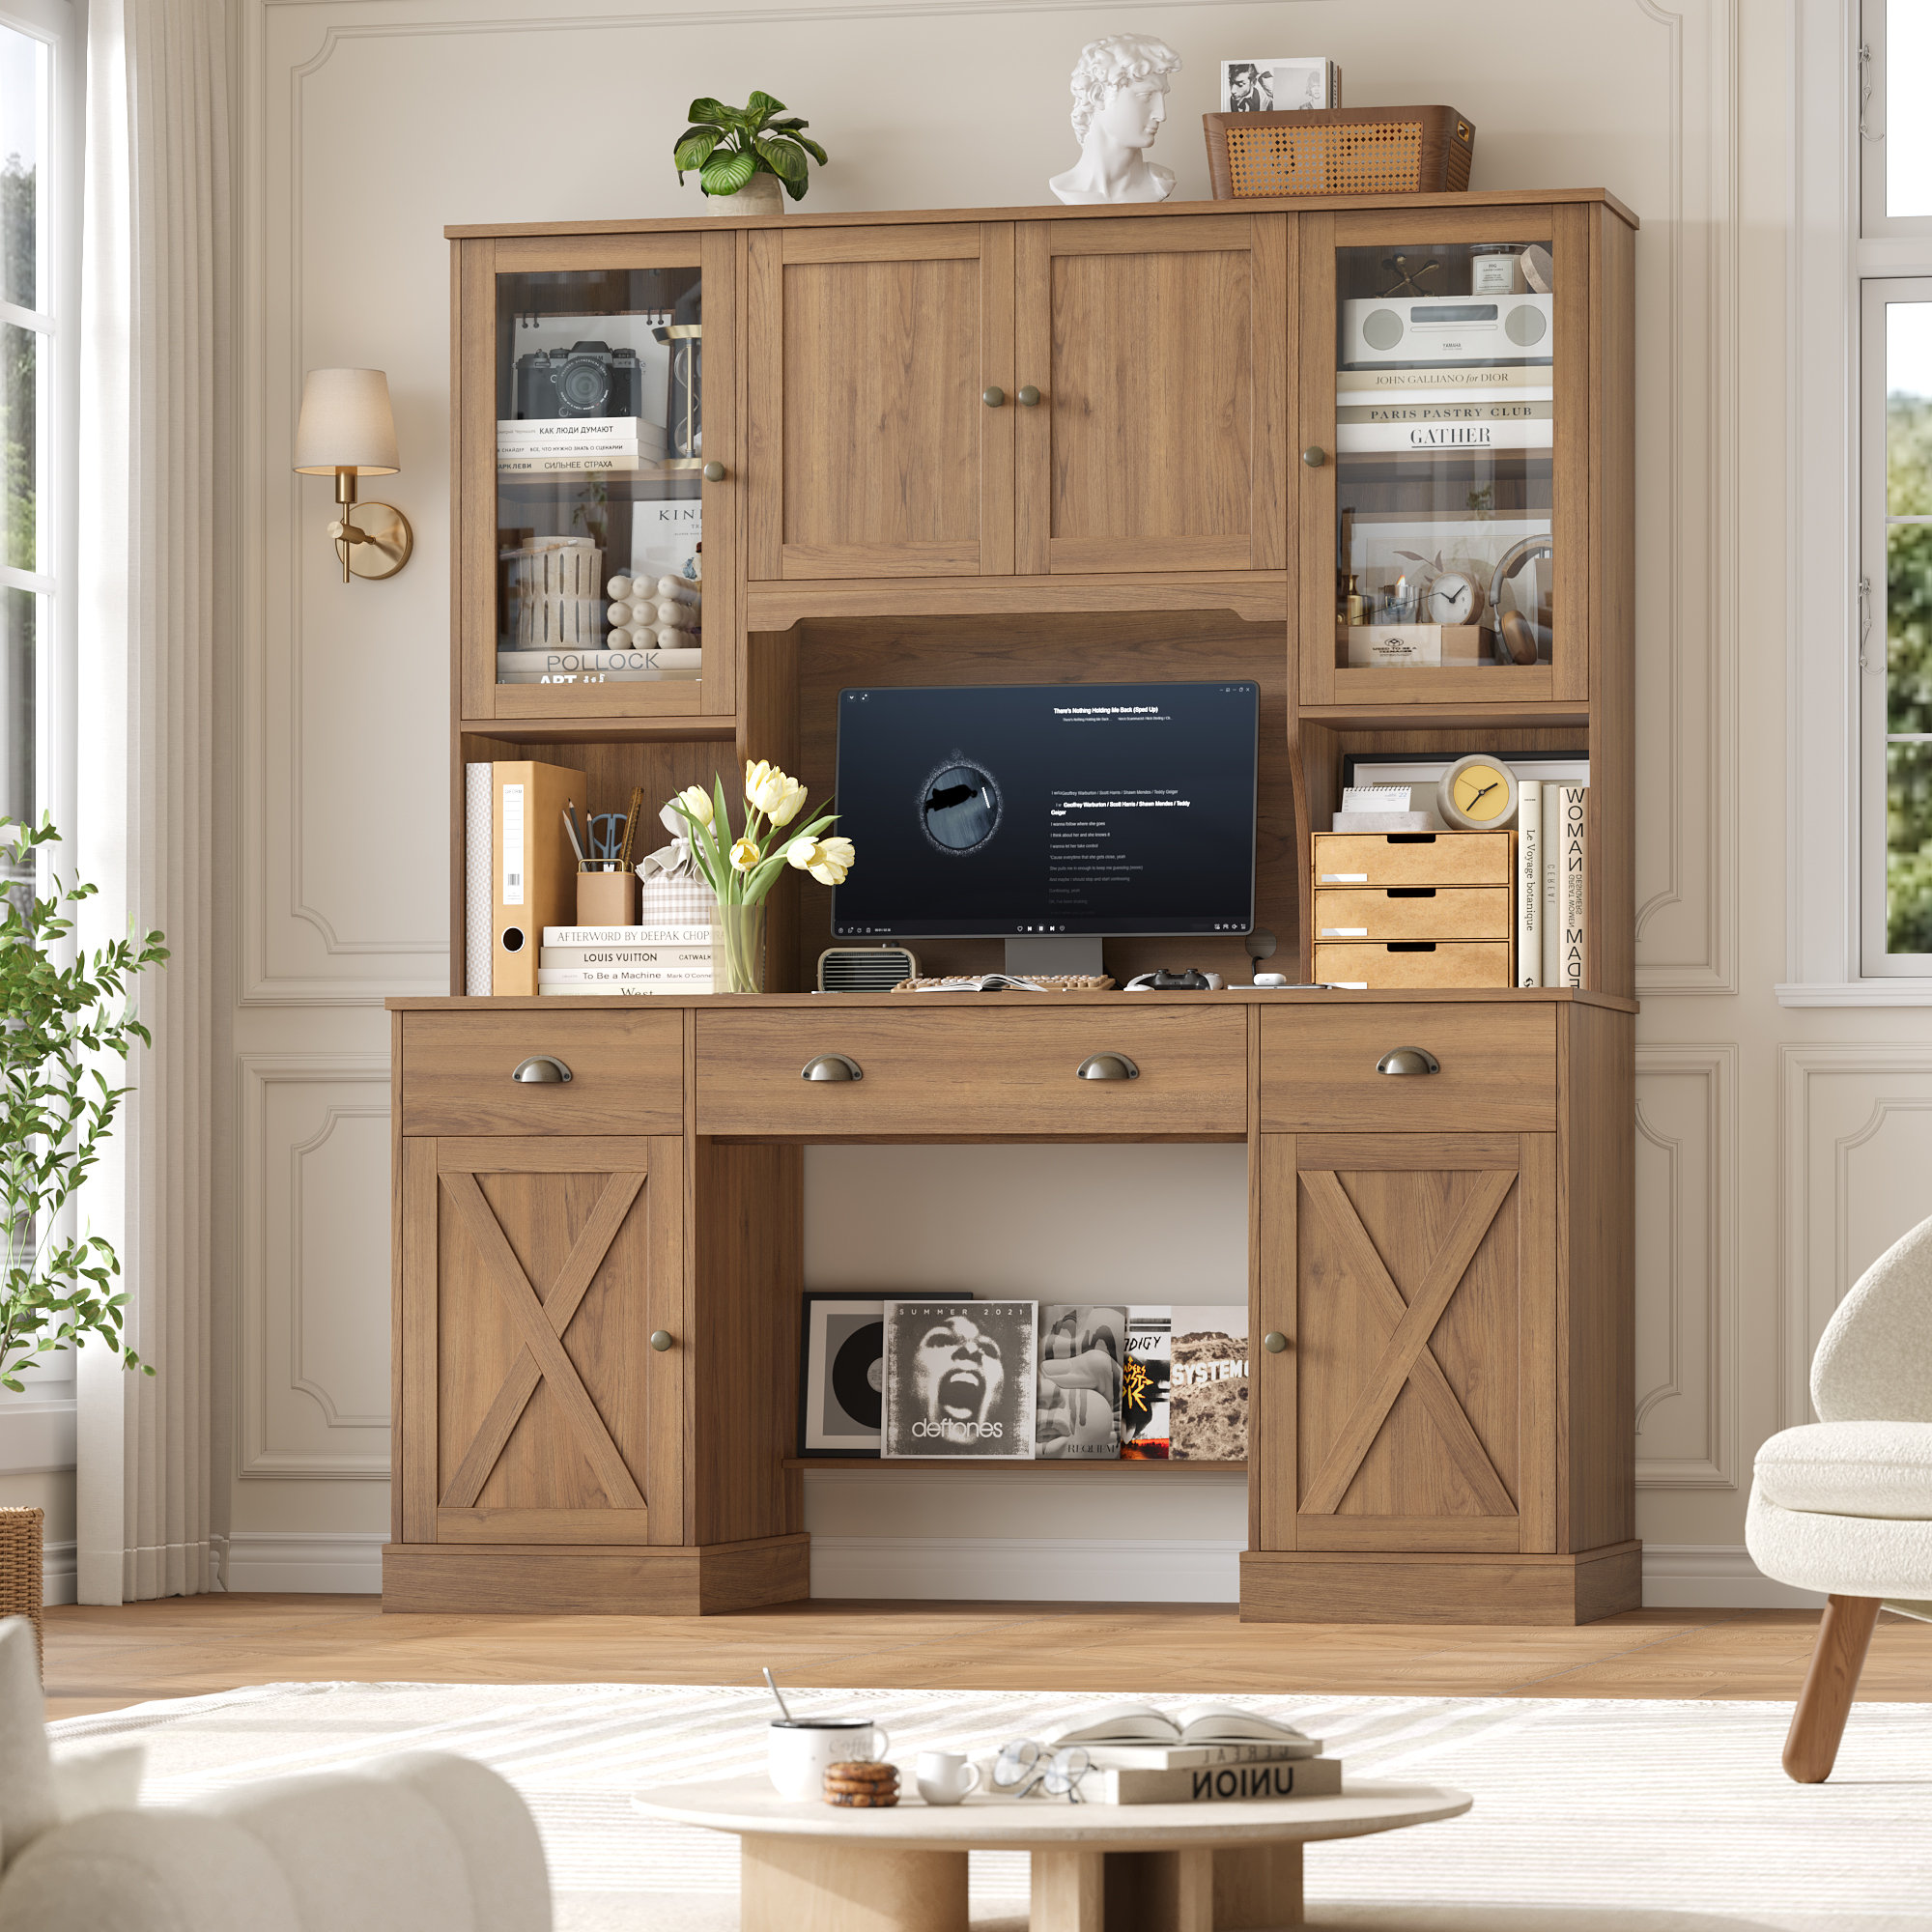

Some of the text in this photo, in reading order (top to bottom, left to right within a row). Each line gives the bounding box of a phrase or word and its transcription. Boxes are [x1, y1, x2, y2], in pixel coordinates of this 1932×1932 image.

[1376, 373, 1509, 384] JOHN GALLIANO for DIOR
[1371, 407, 1532, 419] PARIS PASTRY CLUB
[581, 426, 613, 435] ДУМАЮТ
[1410, 428, 1491, 444] GATHER
[544, 461, 581, 469] СИЛЬНЕЕ
[547, 652, 660, 671] POLLOCK
[1524, 830, 1535, 931] Le Voyage botanique
[557, 929, 724, 942] AFTERWORD BY DEEPAK CHOP
[583, 953, 613, 962] LOUIS
[616, 952, 658, 962] VUITTON
[621, 971, 662, 980] Machine
[1172, 1359, 1243, 1387] SYSTEM
[1124, 1372, 1148, 1389] UST
[912, 1418, 1003, 1438] deftones
